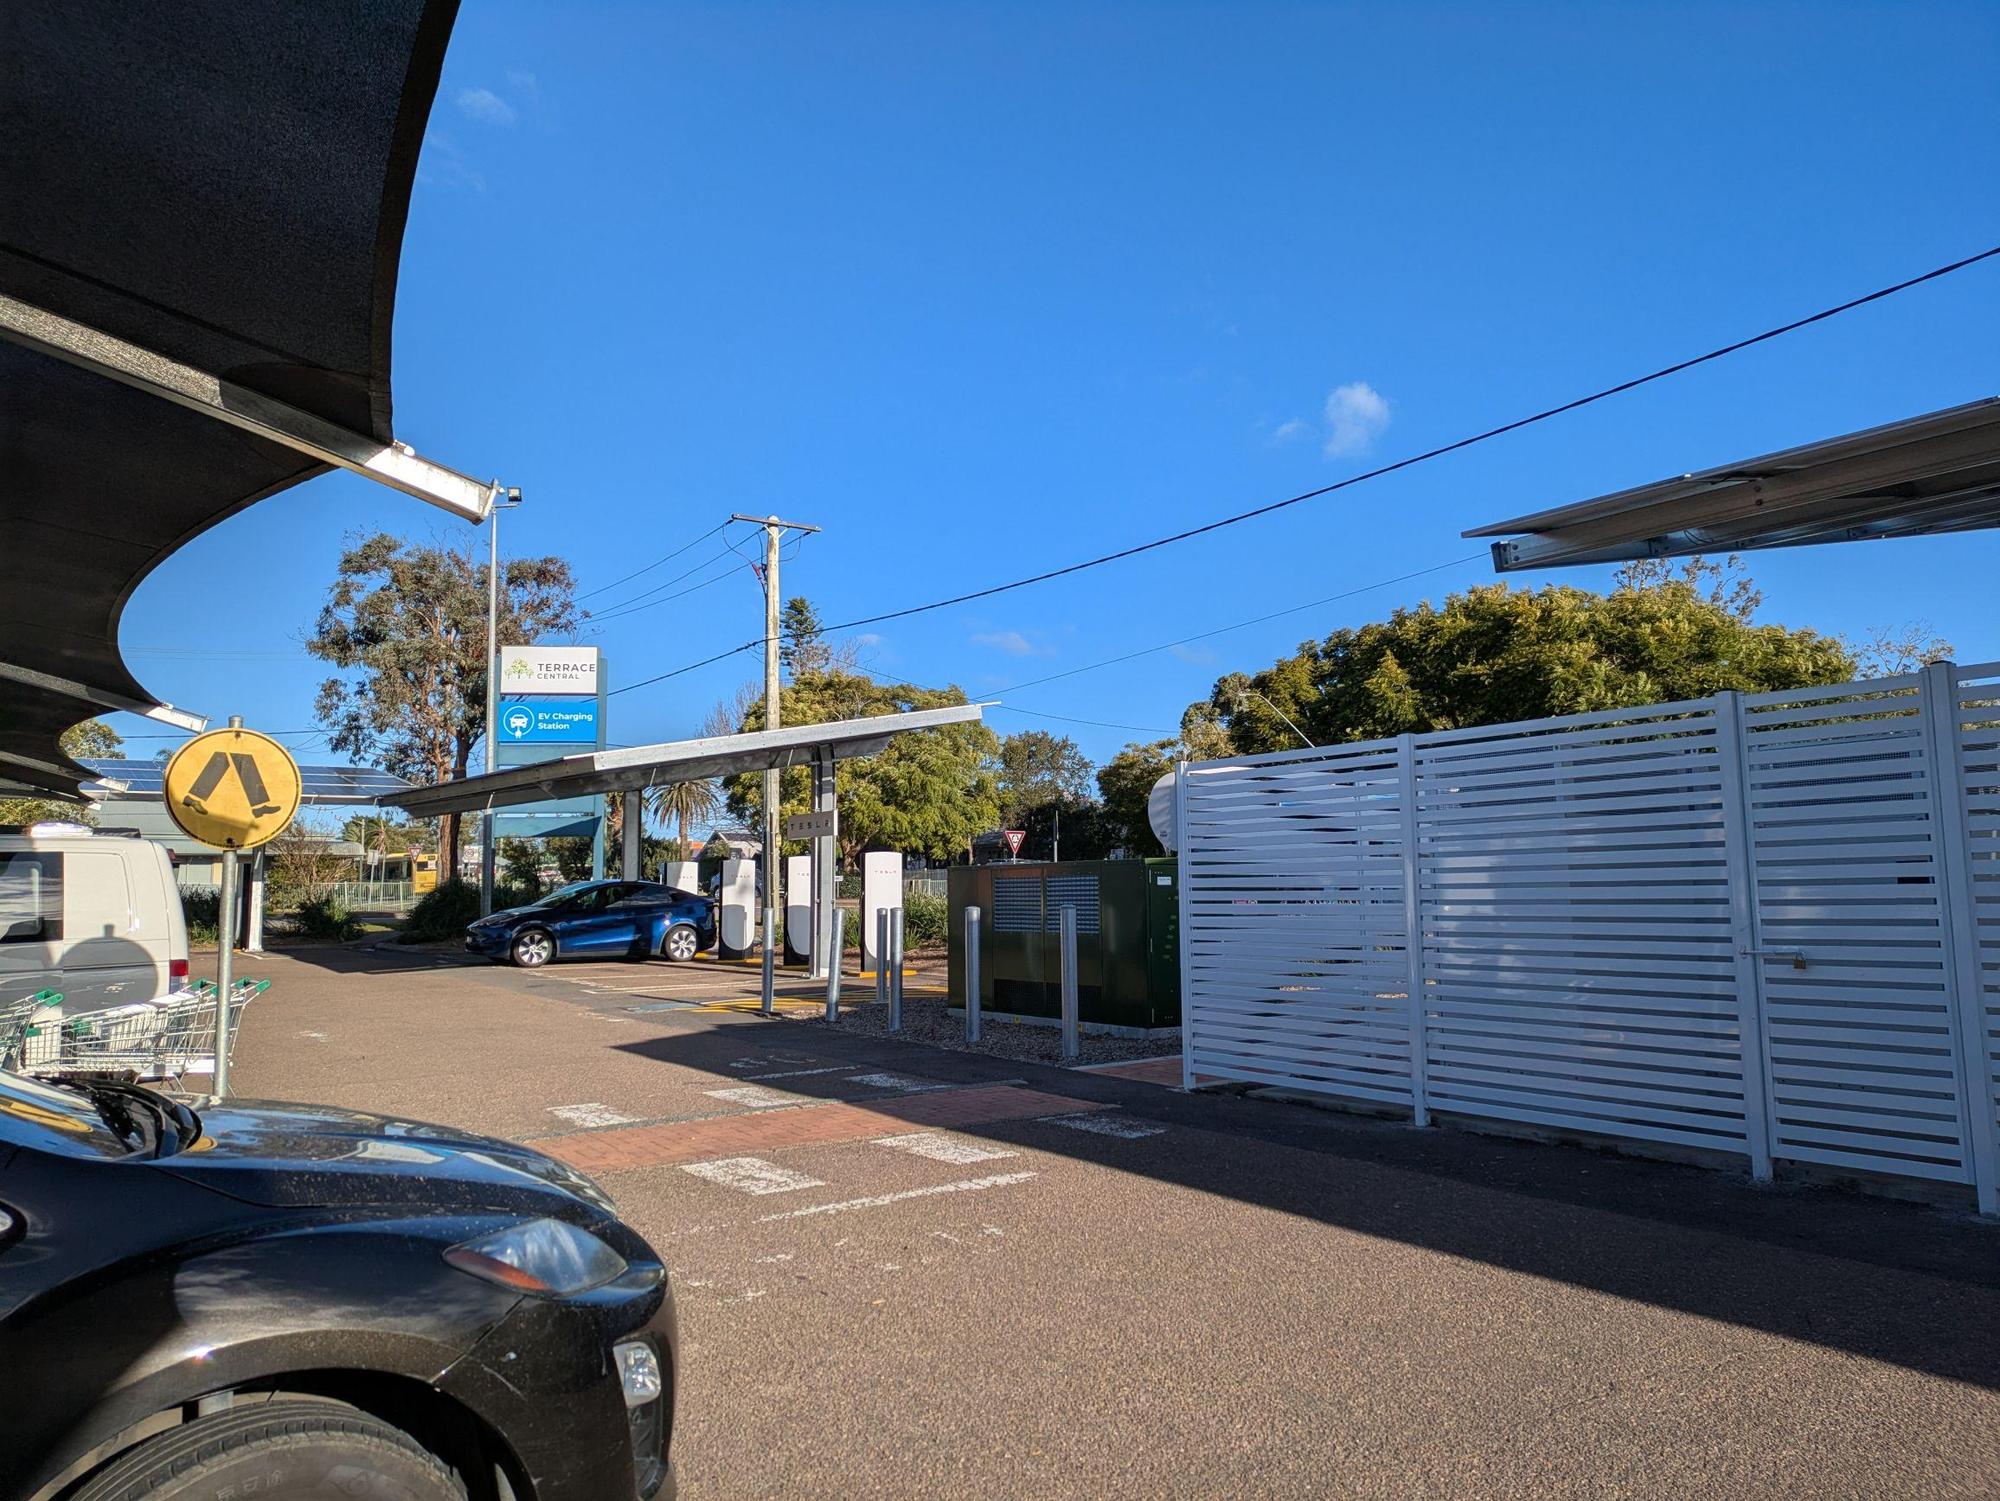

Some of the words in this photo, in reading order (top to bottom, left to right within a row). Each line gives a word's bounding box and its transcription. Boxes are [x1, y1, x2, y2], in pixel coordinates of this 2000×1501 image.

[537, 663, 596, 672] TERRACE
[552, 712, 593, 722] Charging
[538, 722, 570, 730] Station
[790, 819, 830, 830] TESLA
